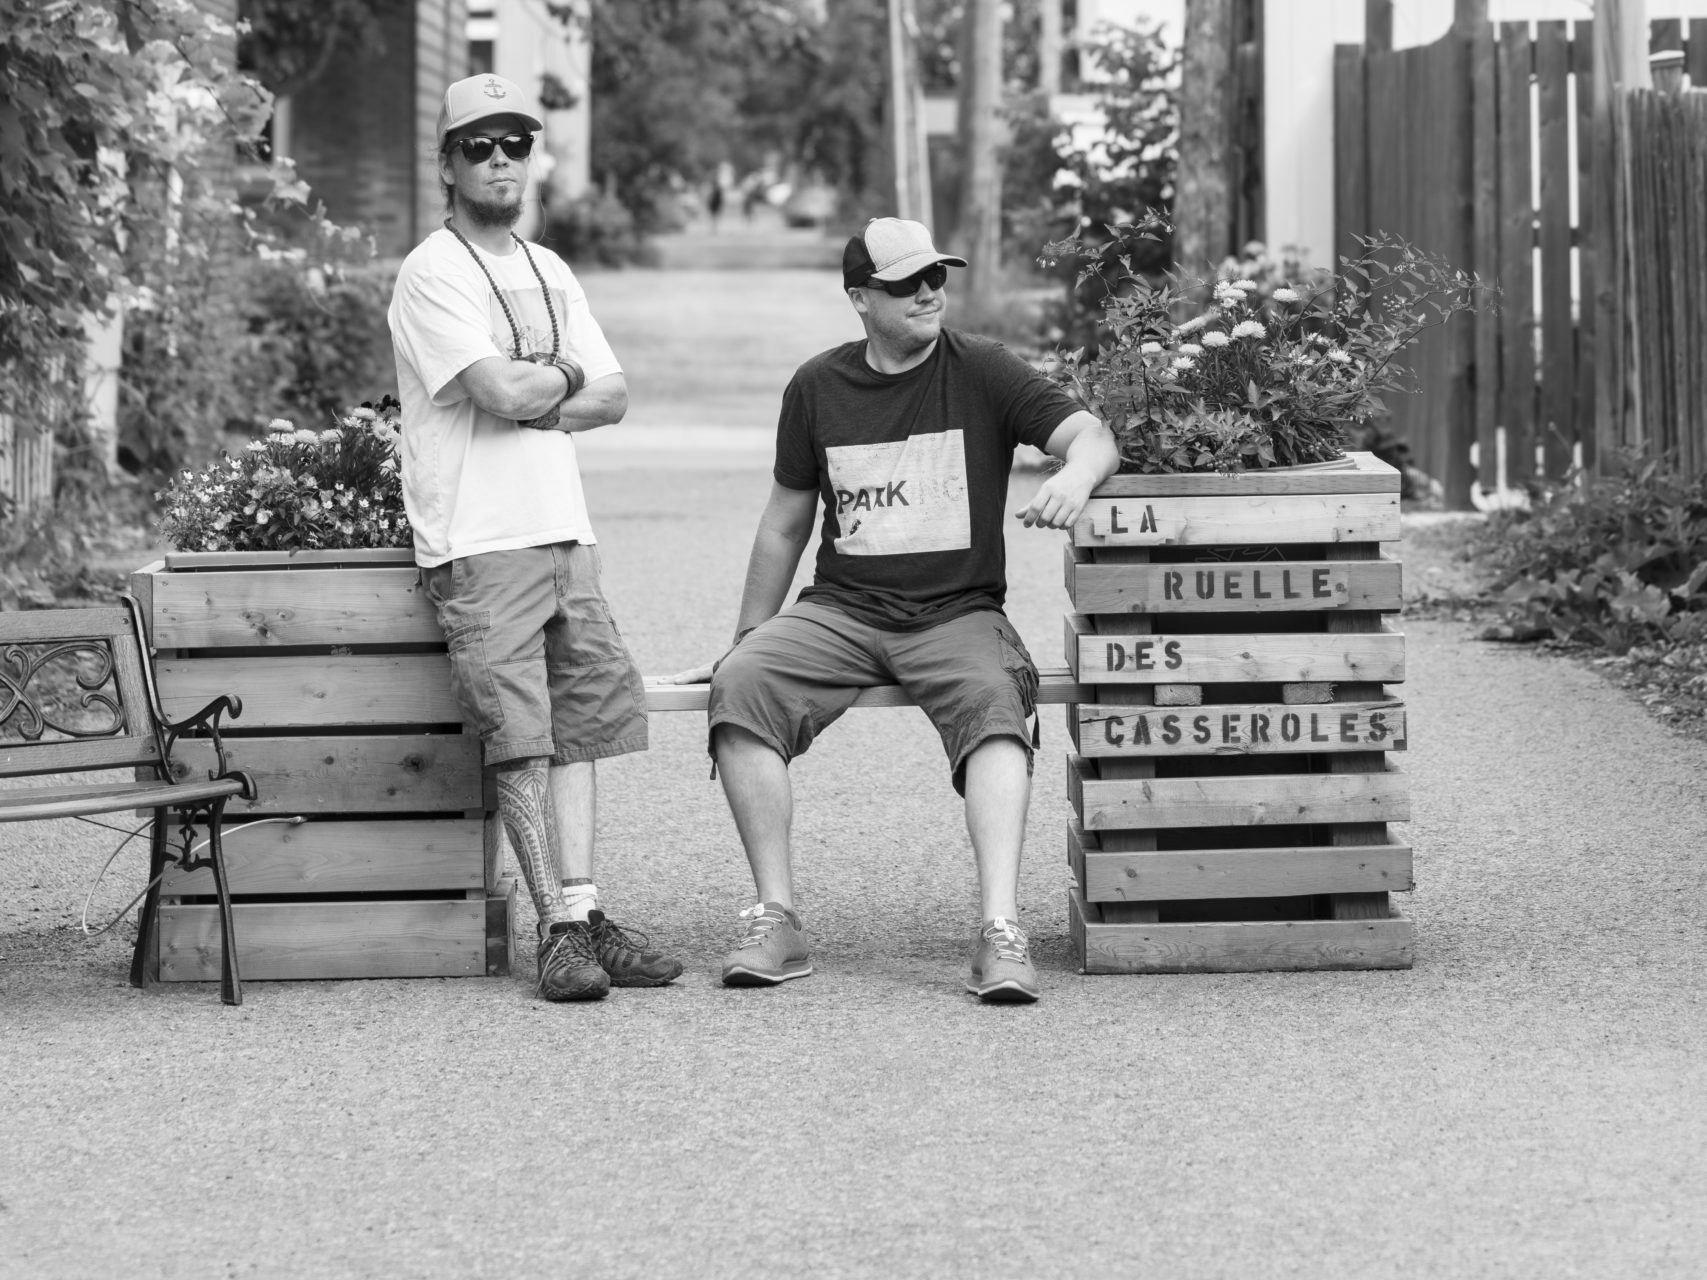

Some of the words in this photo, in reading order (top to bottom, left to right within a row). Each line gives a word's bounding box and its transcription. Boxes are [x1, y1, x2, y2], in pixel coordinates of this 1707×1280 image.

[1111, 505, 1157, 533] LA
[1164, 569, 1332, 600] RUELLE
[1106, 641, 1182, 671] DES
[1105, 713, 1387, 745] CASSEROLES
